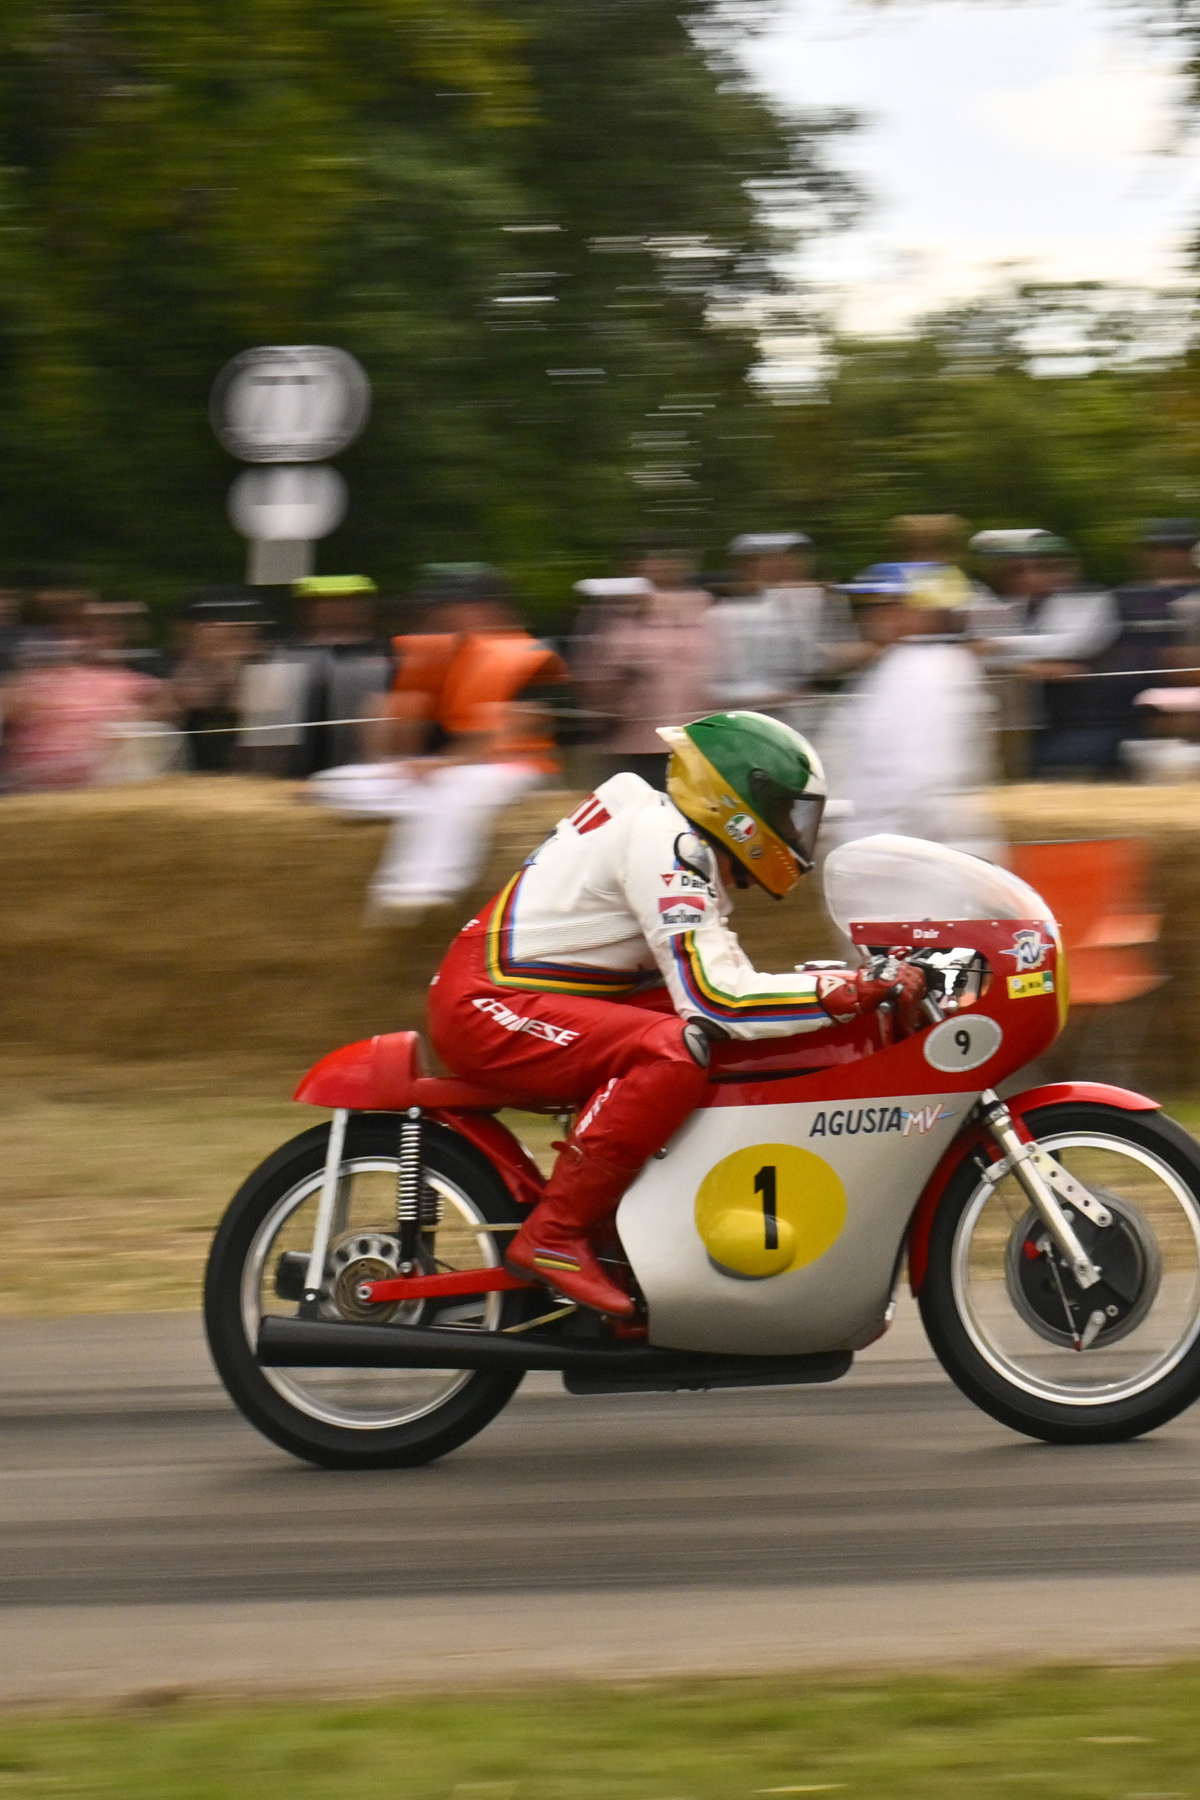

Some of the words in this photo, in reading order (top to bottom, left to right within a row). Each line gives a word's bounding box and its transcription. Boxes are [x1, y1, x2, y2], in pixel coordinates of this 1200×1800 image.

[954, 1029, 971, 1055] 9
[809, 1106, 902, 1137] AGUSTA
[902, 1103, 945, 1137] MV
[754, 1165, 778, 1250] 1
